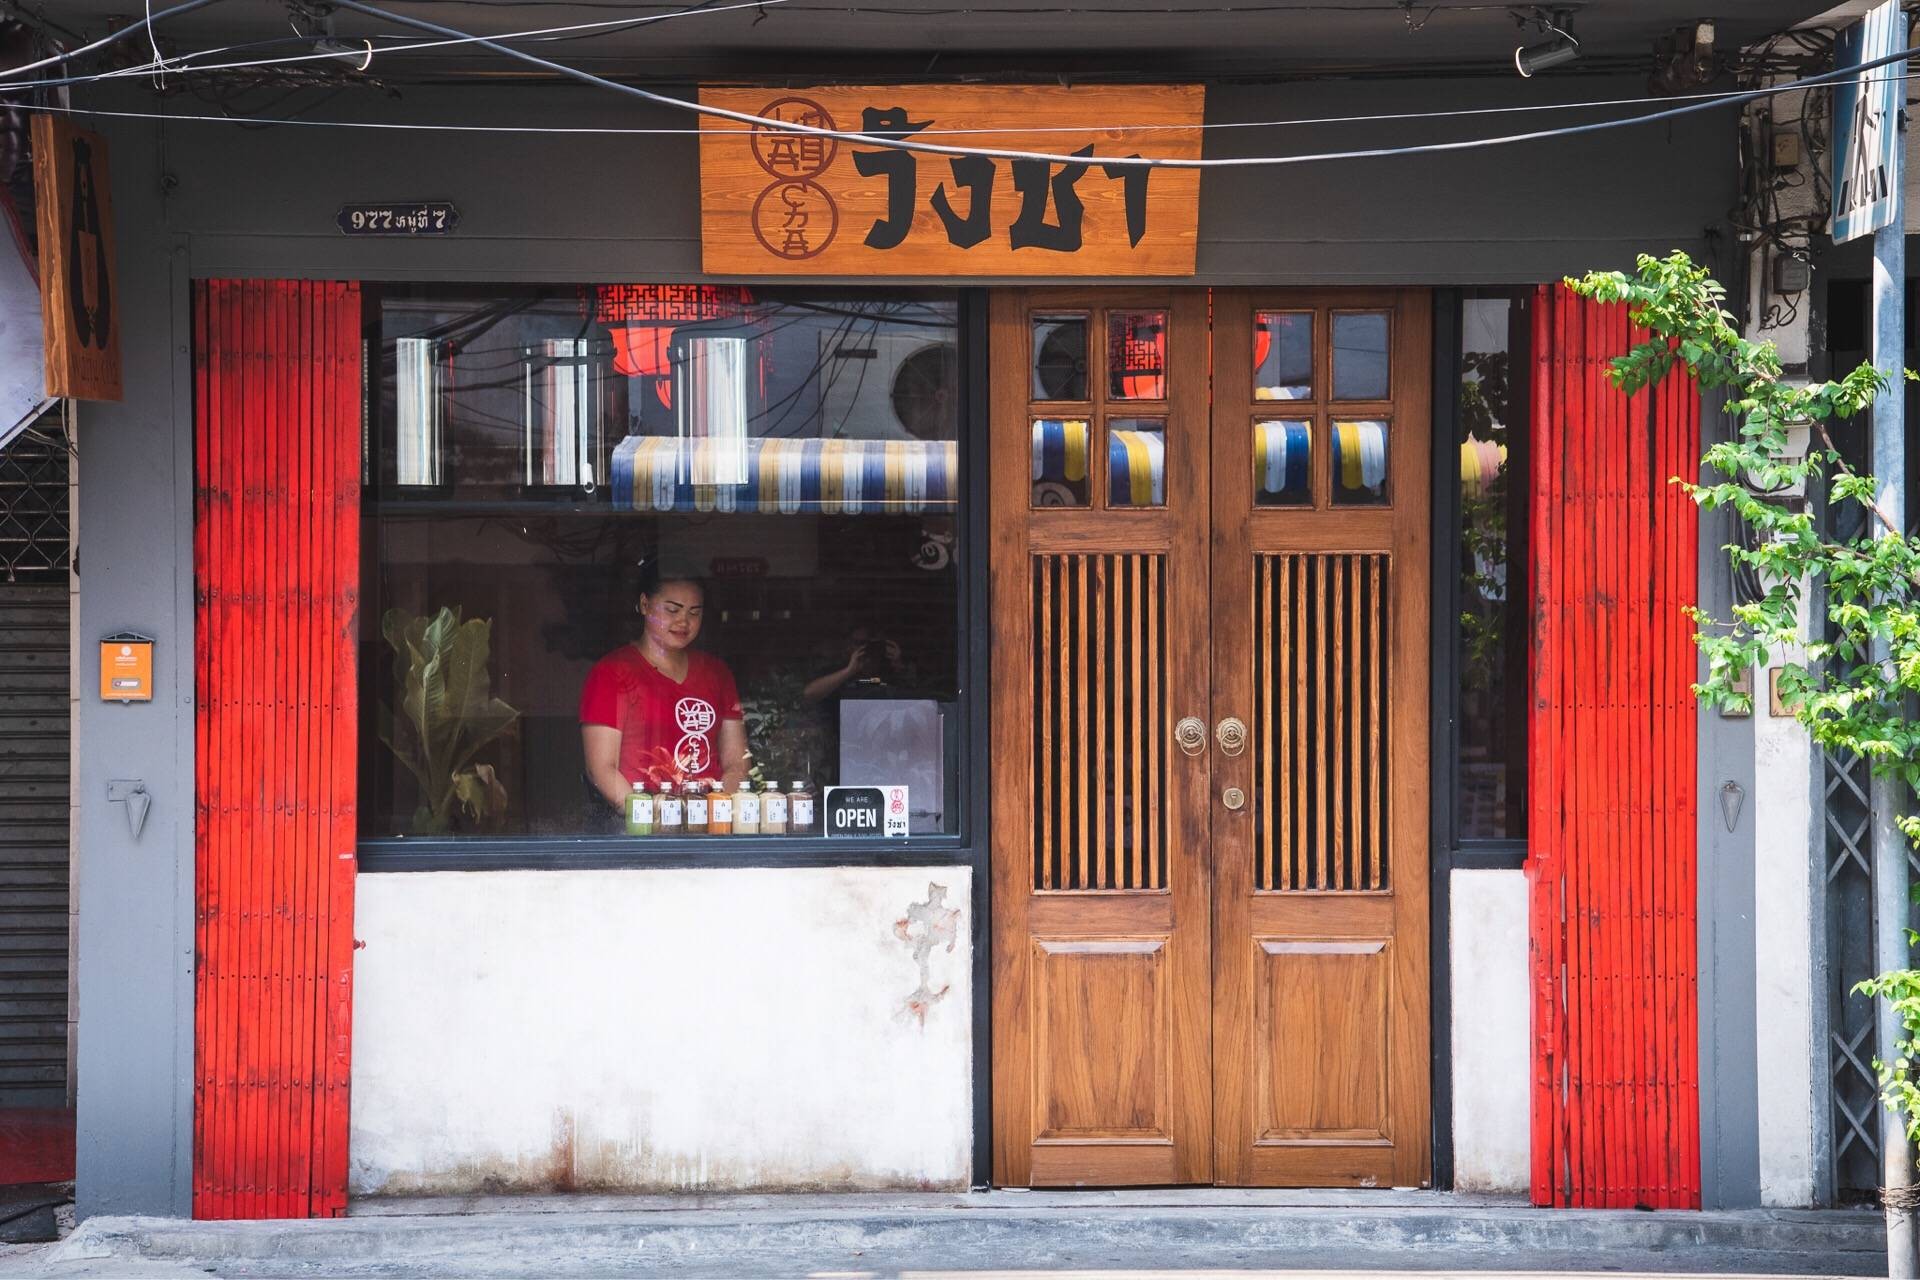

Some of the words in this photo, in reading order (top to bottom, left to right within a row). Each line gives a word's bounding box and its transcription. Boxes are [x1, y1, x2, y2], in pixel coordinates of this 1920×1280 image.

[351, 209, 393, 230] 977
[433, 209, 446, 230] 7
[845, 796, 855, 804] WE
[856, 796, 869, 804] ARE
[835, 808, 877, 828] OPEN
